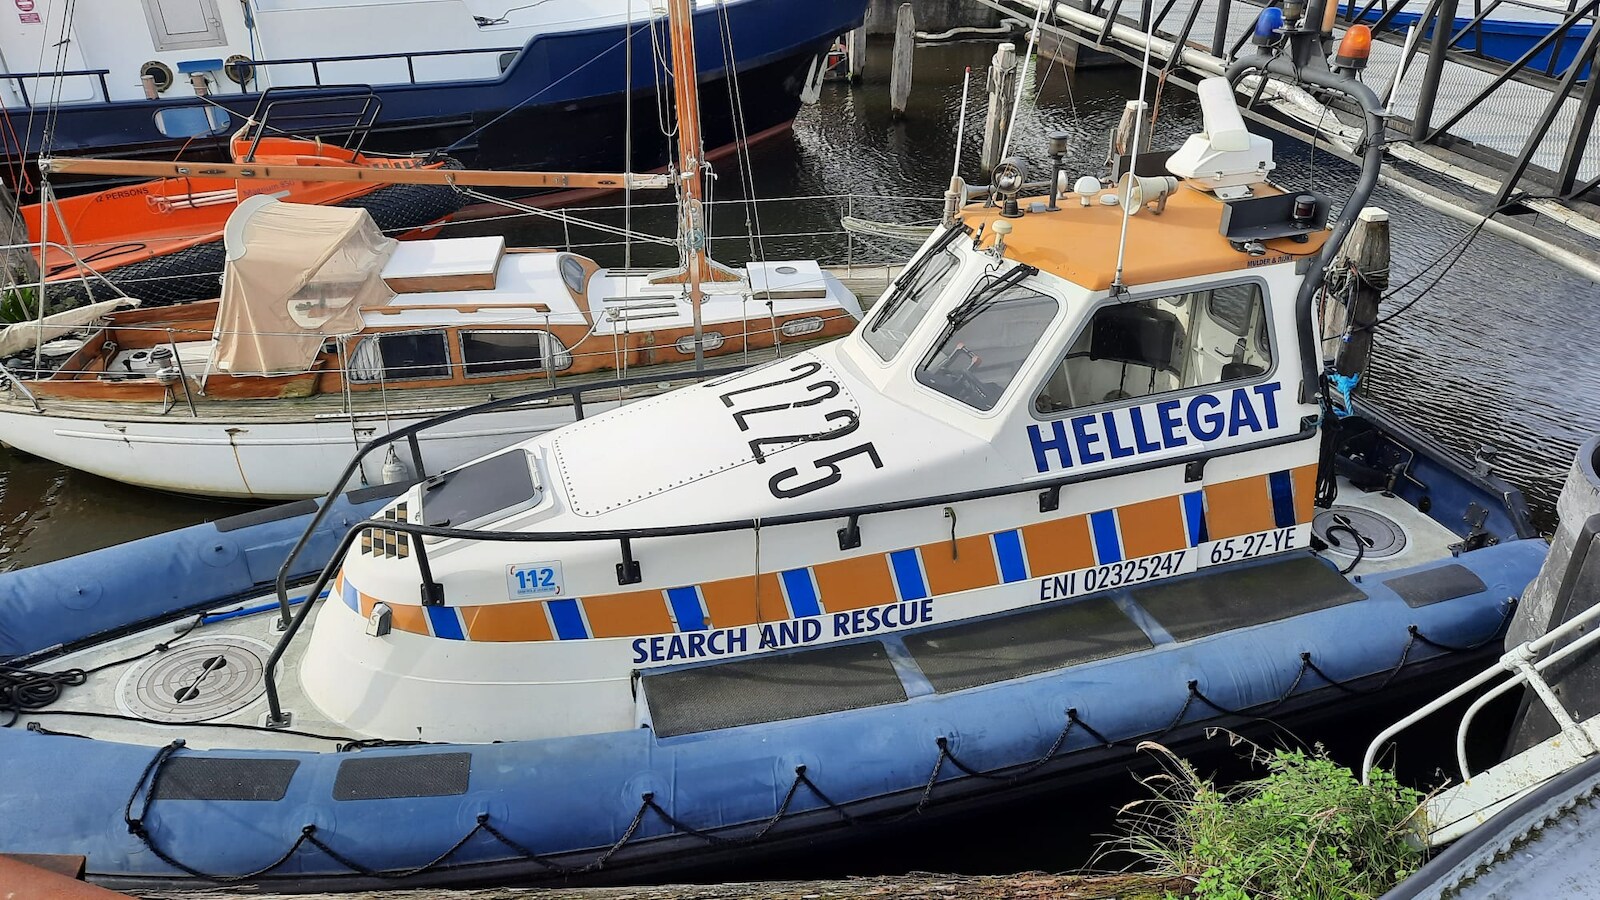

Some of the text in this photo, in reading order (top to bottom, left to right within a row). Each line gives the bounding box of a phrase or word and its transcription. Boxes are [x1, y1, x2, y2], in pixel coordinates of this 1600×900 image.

[105, 187, 149, 200] PERSONS
[704, 357, 884, 499] 2225
[1026, 381, 1281, 473] HELLEGAT
[1210, 527, 1297, 564] 65-27-YE
[1040, 551, 1187, 601] ENI 02325247
[632, 599, 934, 664] SEARCH AND RESCUE
